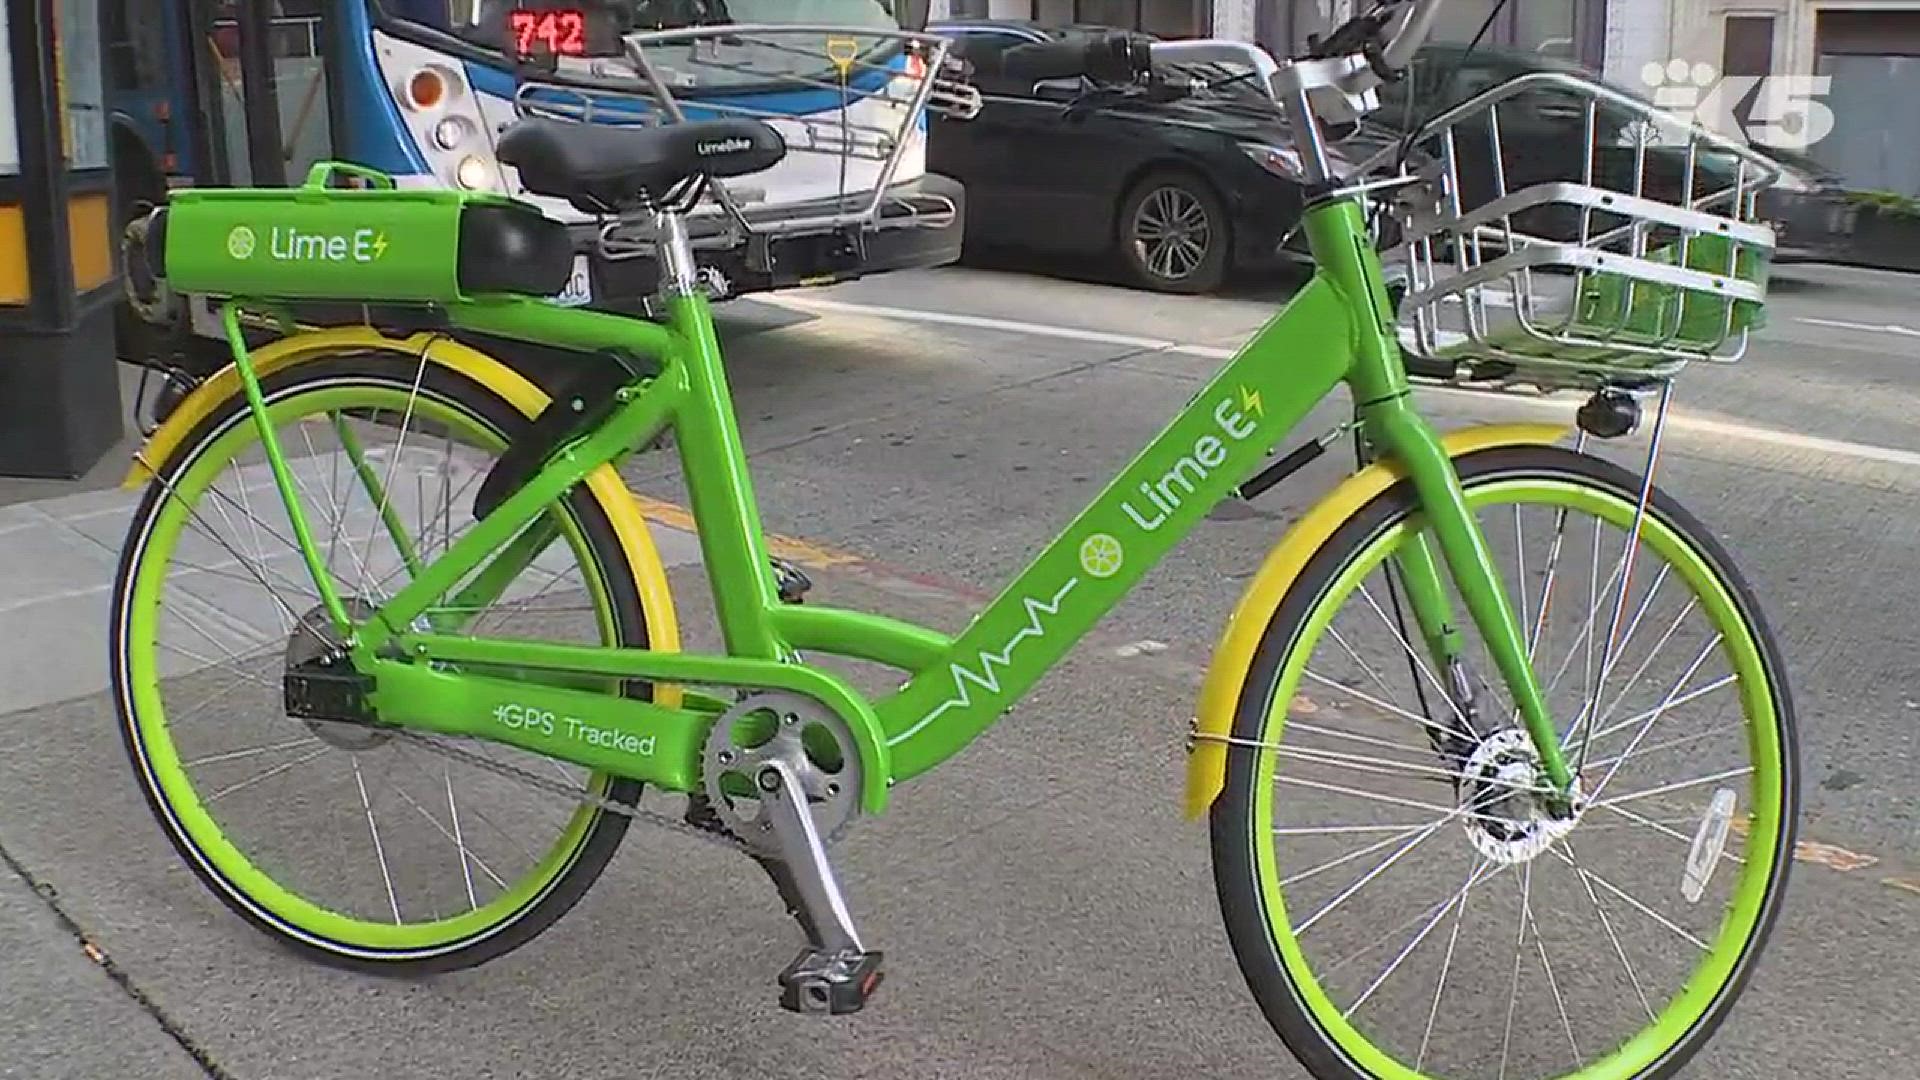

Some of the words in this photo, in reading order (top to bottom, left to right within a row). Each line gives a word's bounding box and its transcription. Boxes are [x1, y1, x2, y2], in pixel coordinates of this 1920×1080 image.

[511, 12, 583, 53] 742
[697, 138, 751, 156] LimeBike
[270, 225, 347, 261] Lime
[1120, 435, 1227, 531] Lime
[563, 716, 657, 756] Tracked
